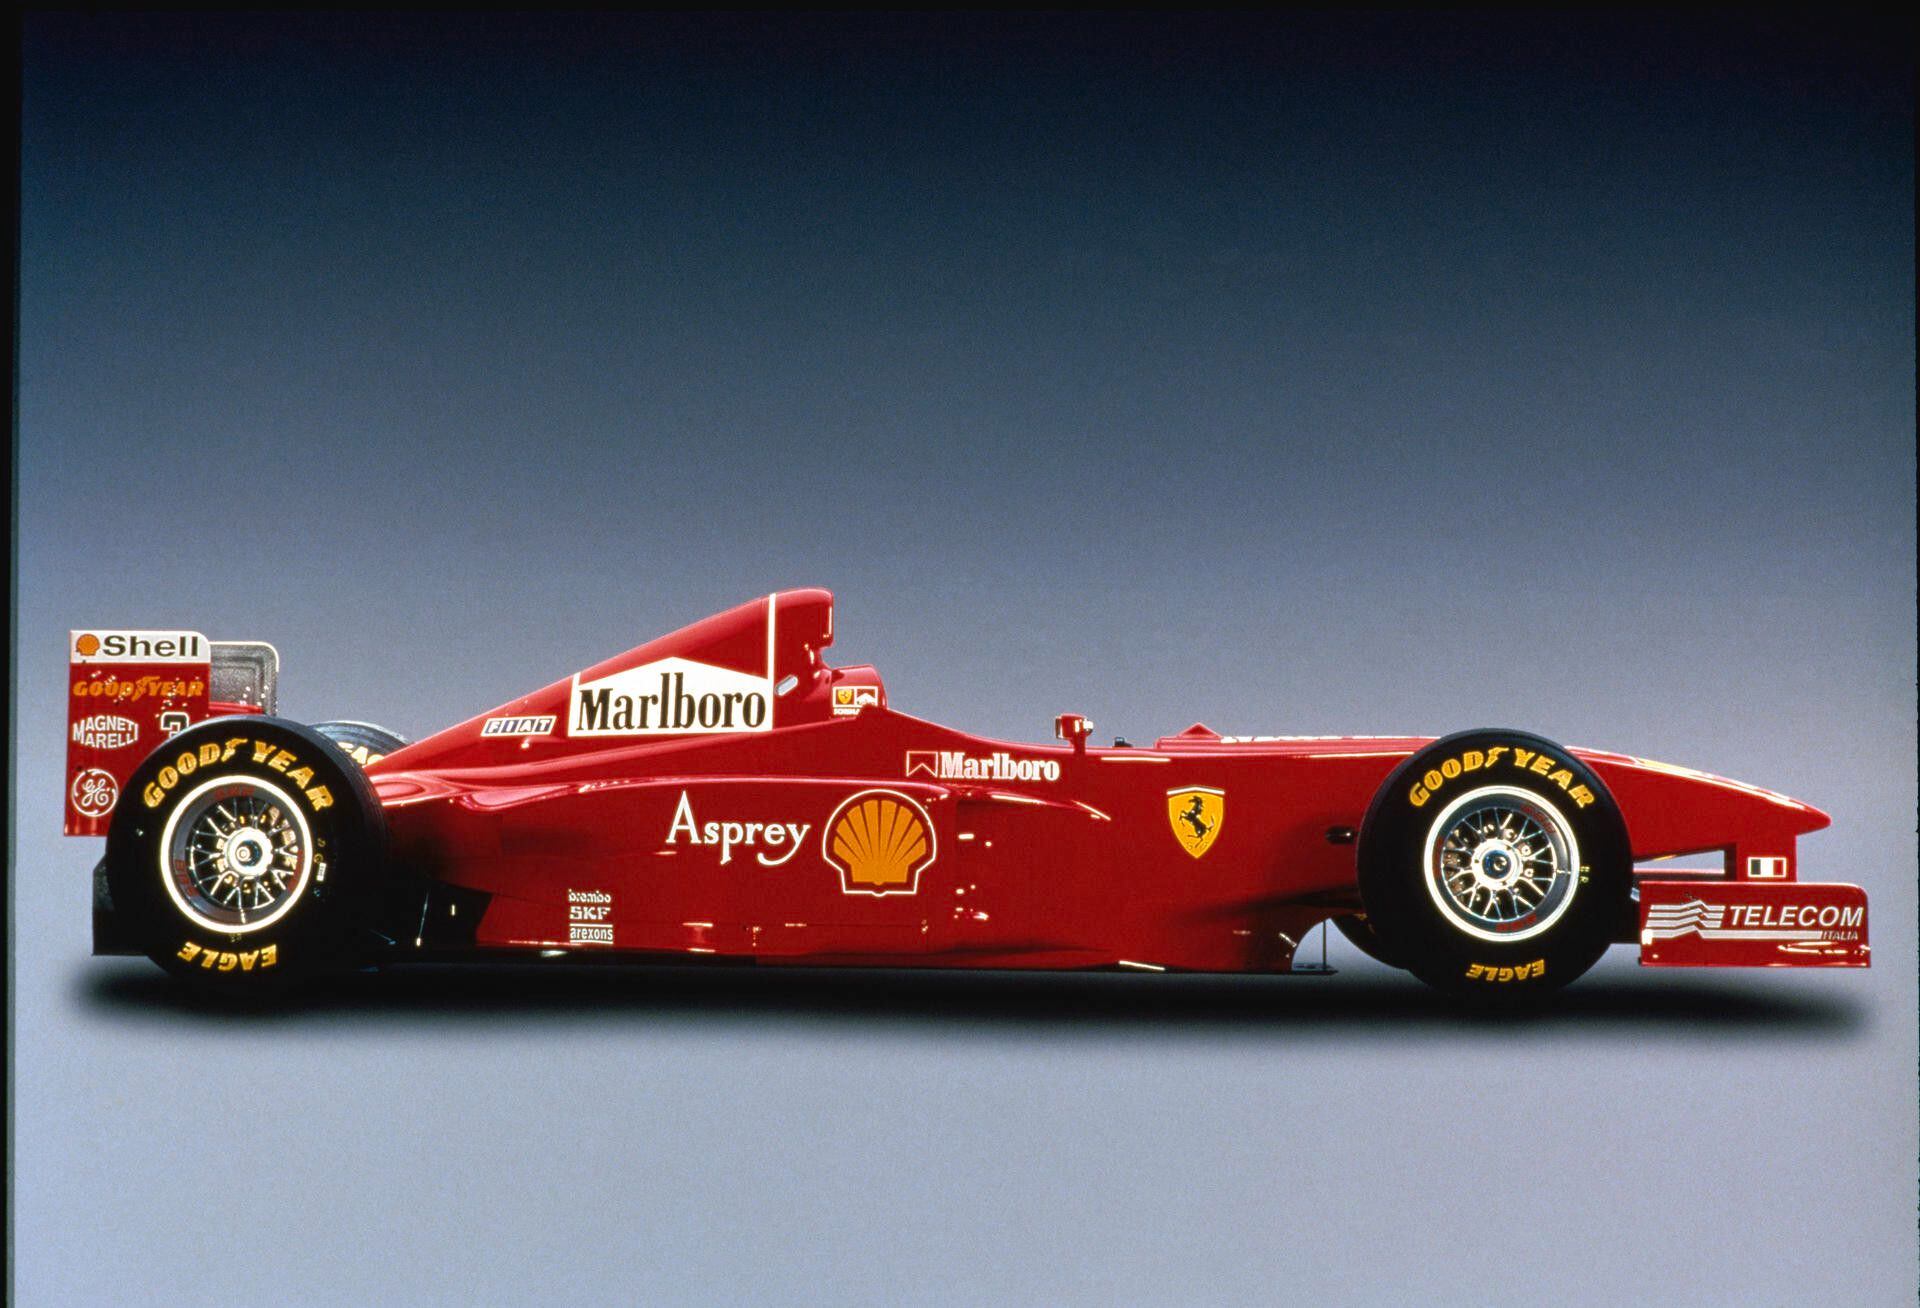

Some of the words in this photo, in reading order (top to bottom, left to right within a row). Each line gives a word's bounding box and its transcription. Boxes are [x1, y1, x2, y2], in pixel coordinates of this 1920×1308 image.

[103, 635, 198, 657] Shell
[576, 673, 766, 731] Marlboro
[73, 715, 138, 738] MAGNETI
[485, 718, 553, 734] FIAT
[939, 752, 1060, 781] Marlboro
[665, 790, 811, 866] Asprey
[568, 889, 611, 903] brembo
[570, 906, 611, 920] SKF
[1729, 905, 1864, 927] TELECOM
[570, 927, 613, 941] arexons
[1822, 930, 1859, 941] ITALIA
[177, 941, 278, 971] EAGLE
[1465, 959, 1545, 982] EAGLE
